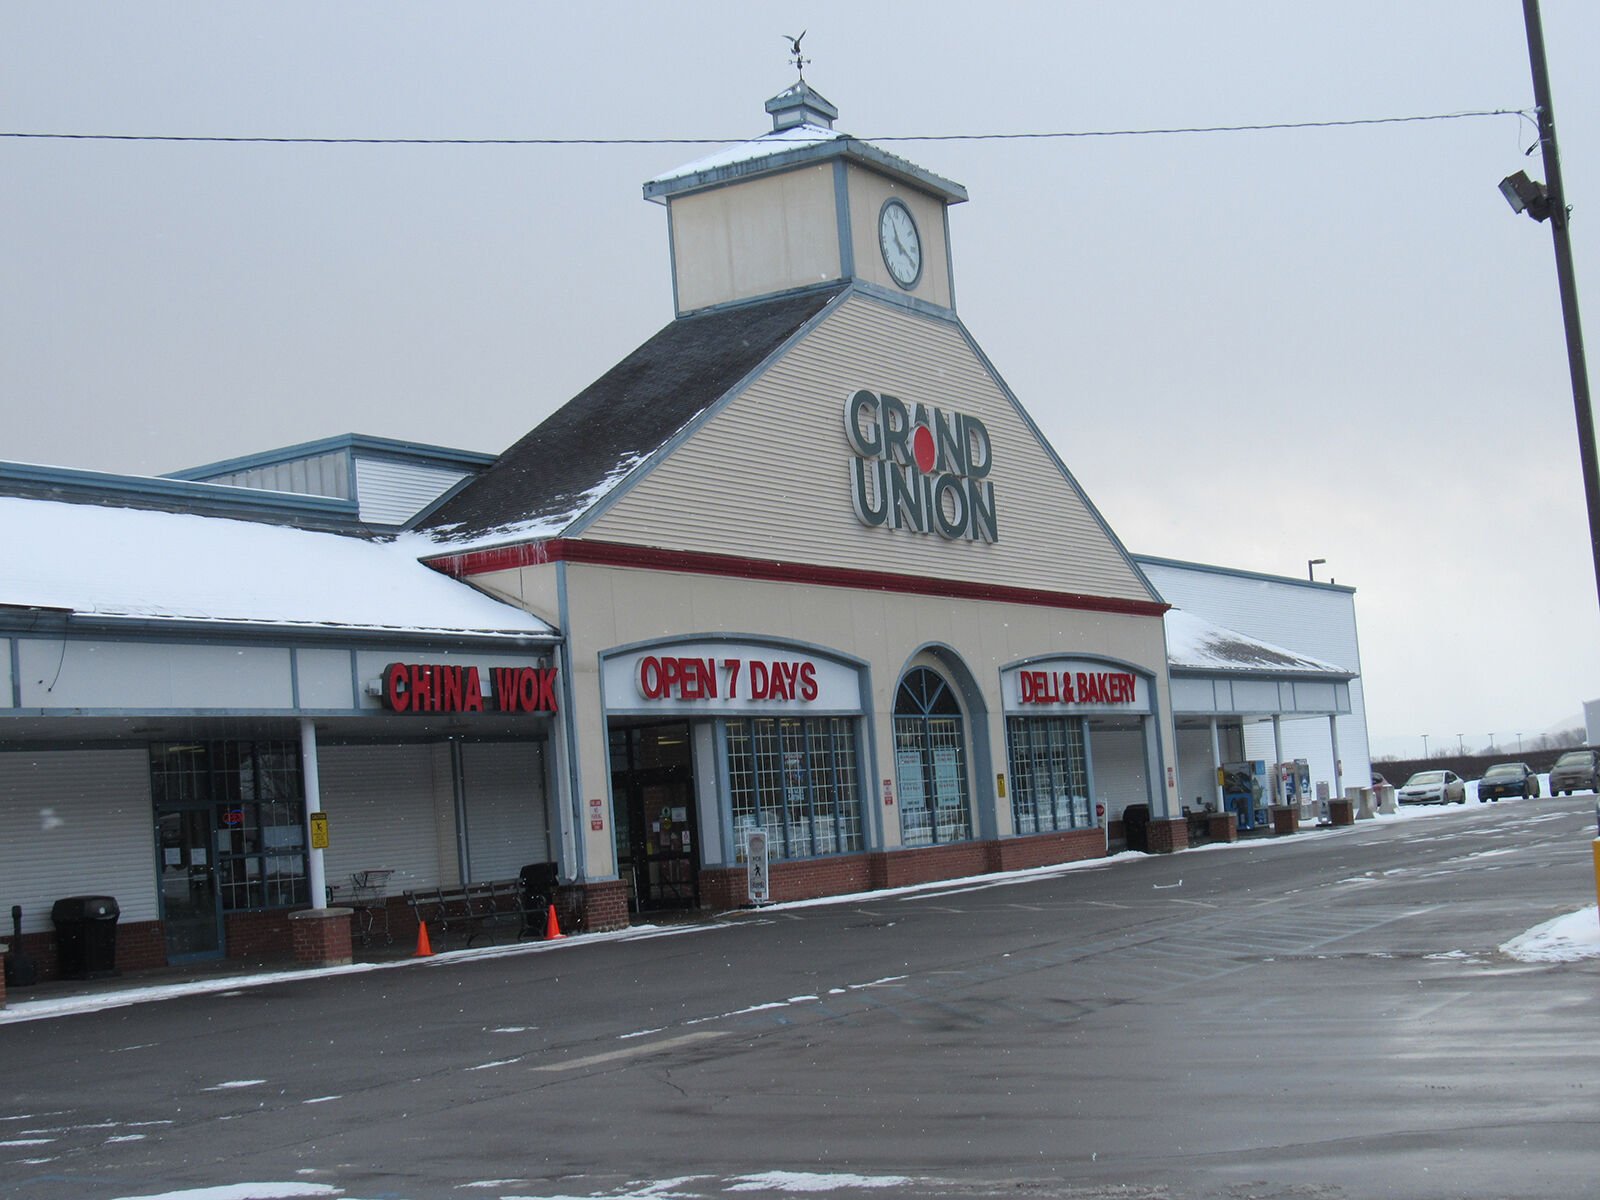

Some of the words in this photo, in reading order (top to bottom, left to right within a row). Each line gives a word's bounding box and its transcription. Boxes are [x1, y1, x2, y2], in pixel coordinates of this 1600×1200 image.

[845, 389, 993, 479] GRAND
[850, 456, 999, 543] UNION
[385, 662, 484, 713] CHINA
[493, 666, 558, 712] WOK
[638, 655, 717, 699] OPEN
[721, 659, 741, 699] 7
[749, 660, 818, 701] DAYS
[1019, 671, 1060, 703] DELI
[1062, 671, 1075, 704] &
[1077, 672, 1136, 703] BAKERY
